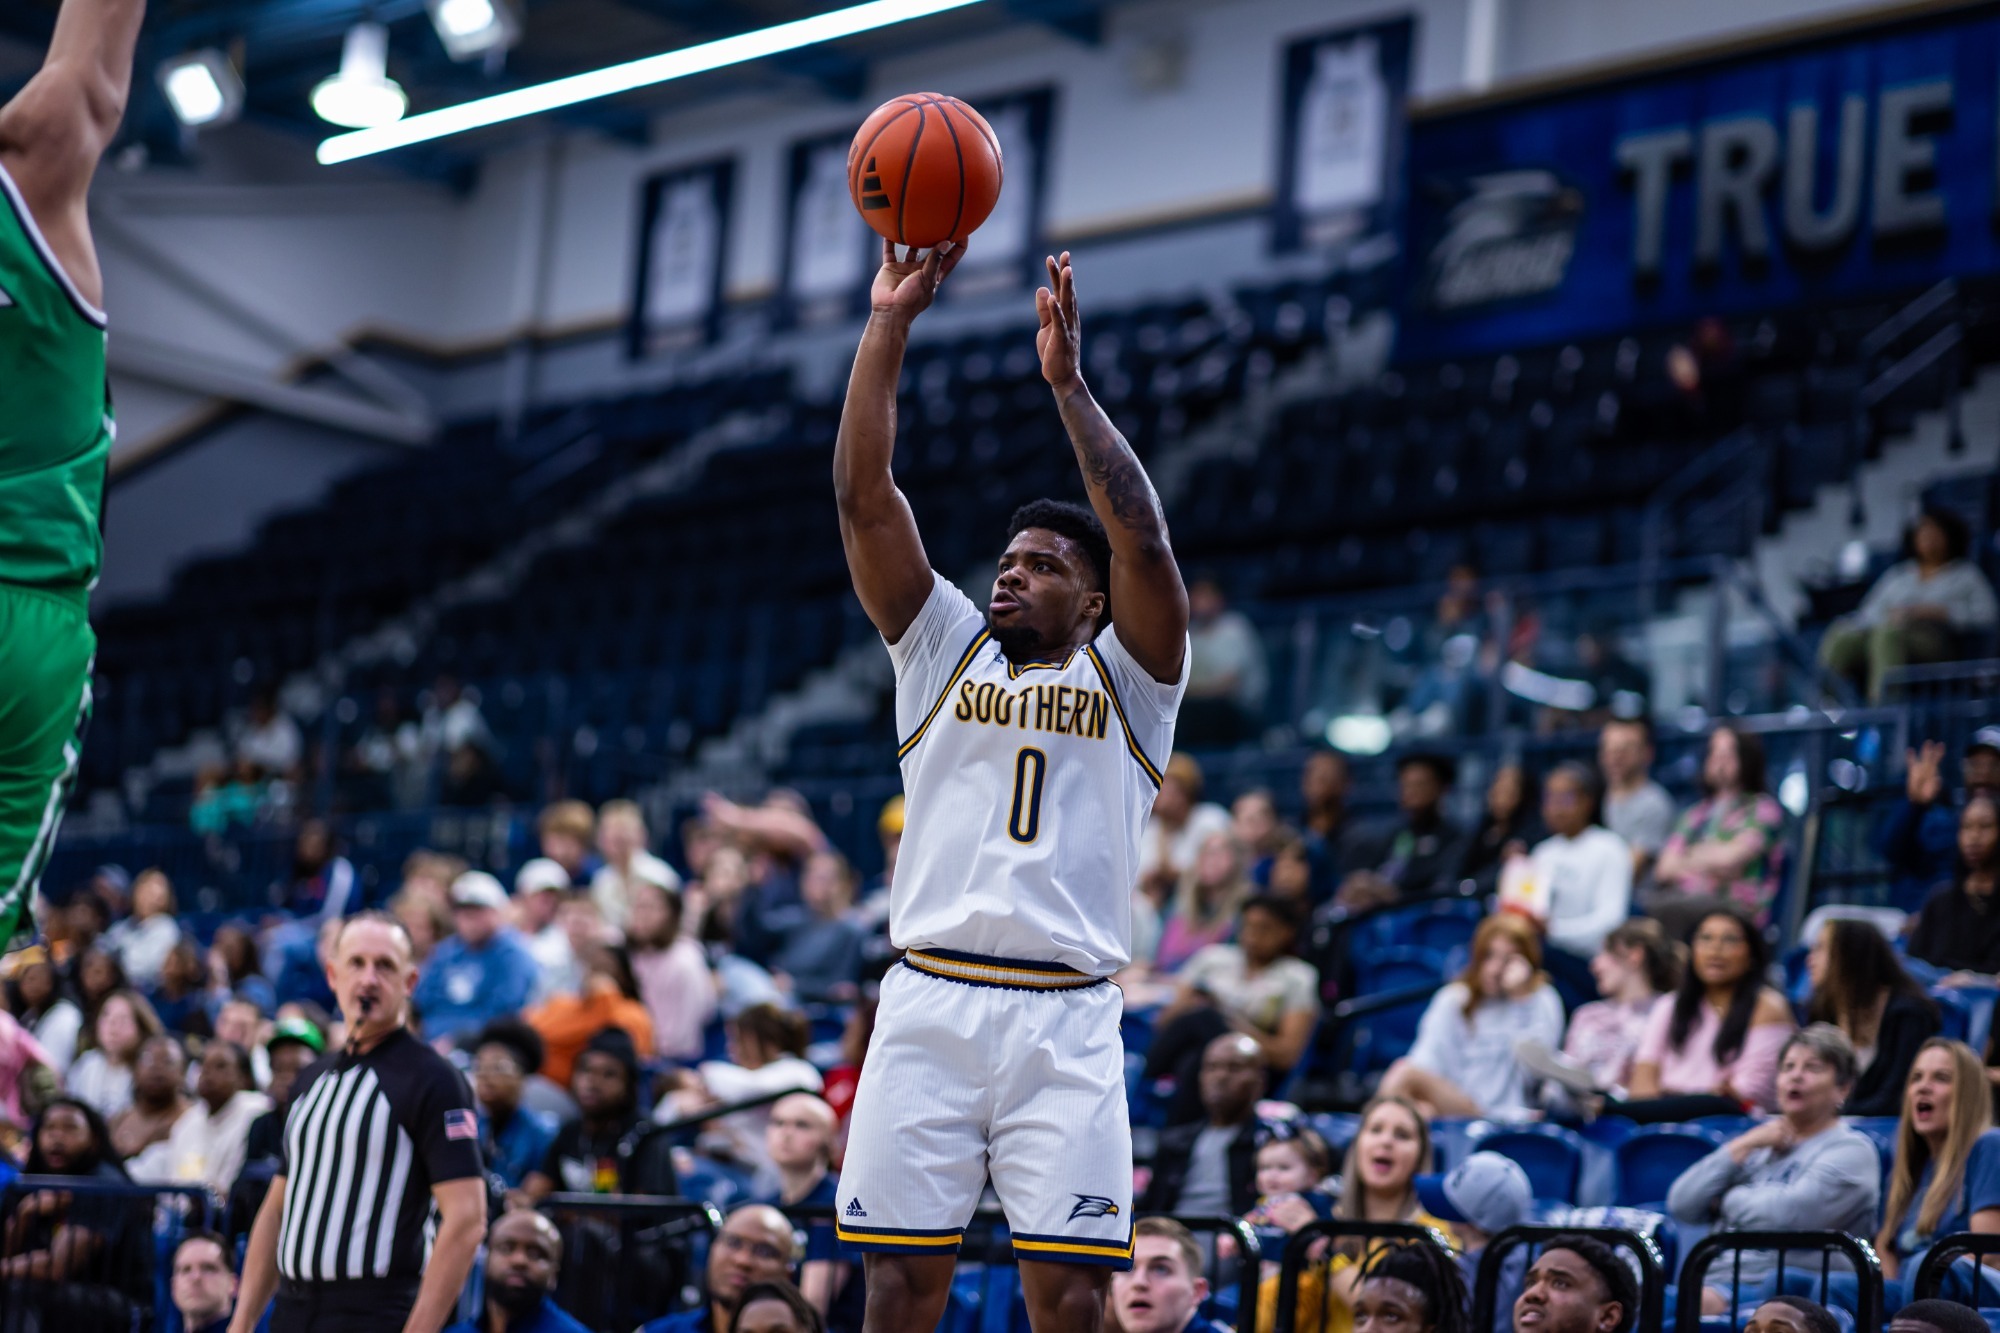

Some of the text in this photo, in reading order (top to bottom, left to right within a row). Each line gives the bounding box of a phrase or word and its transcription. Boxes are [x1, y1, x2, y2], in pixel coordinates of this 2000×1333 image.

[1614, 80, 1953, 282] TRUE
[955, 679, 1109, 740] SOUTHERN
[1008, 746, 1047, 844] 0
